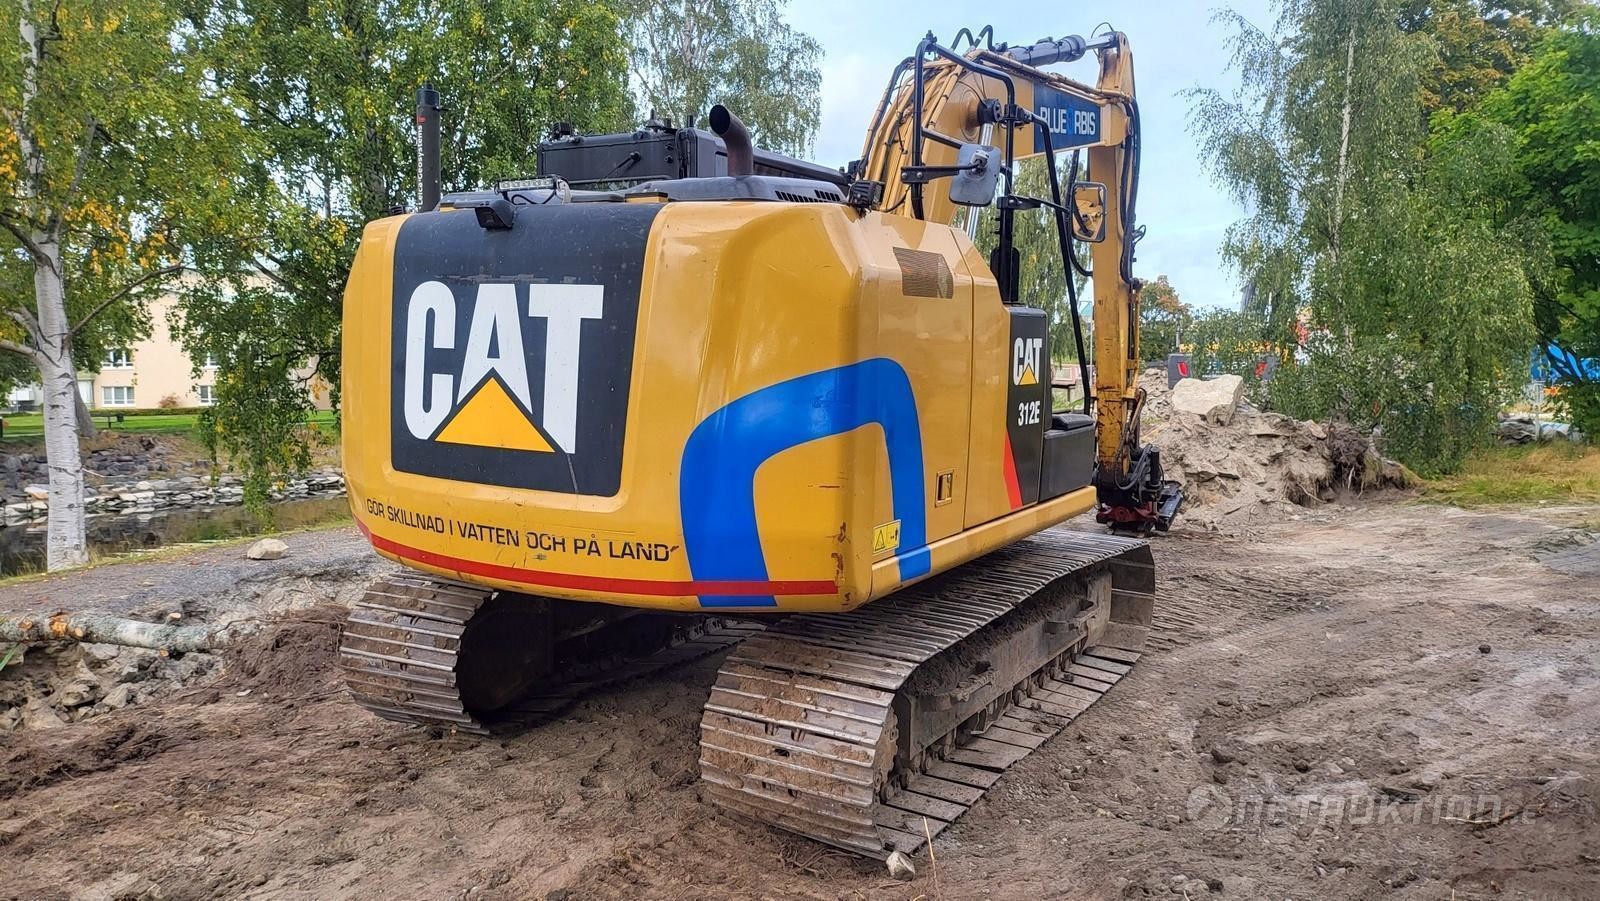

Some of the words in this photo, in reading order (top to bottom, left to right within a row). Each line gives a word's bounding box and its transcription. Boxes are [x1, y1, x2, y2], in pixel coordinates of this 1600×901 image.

[404, 281, 604, 454] CAT
[1013, 337, 1042, 386] CAT
[1017, 401, 1041, 427] 312E
[387, 505, 445, 534] SKILLNAD
[449, 519, 454, 536] I
[457, 520, 520, 547] VATTEN
[525, 531, 567, 554] OCH
[573, 533, 602, 557] PÅ
